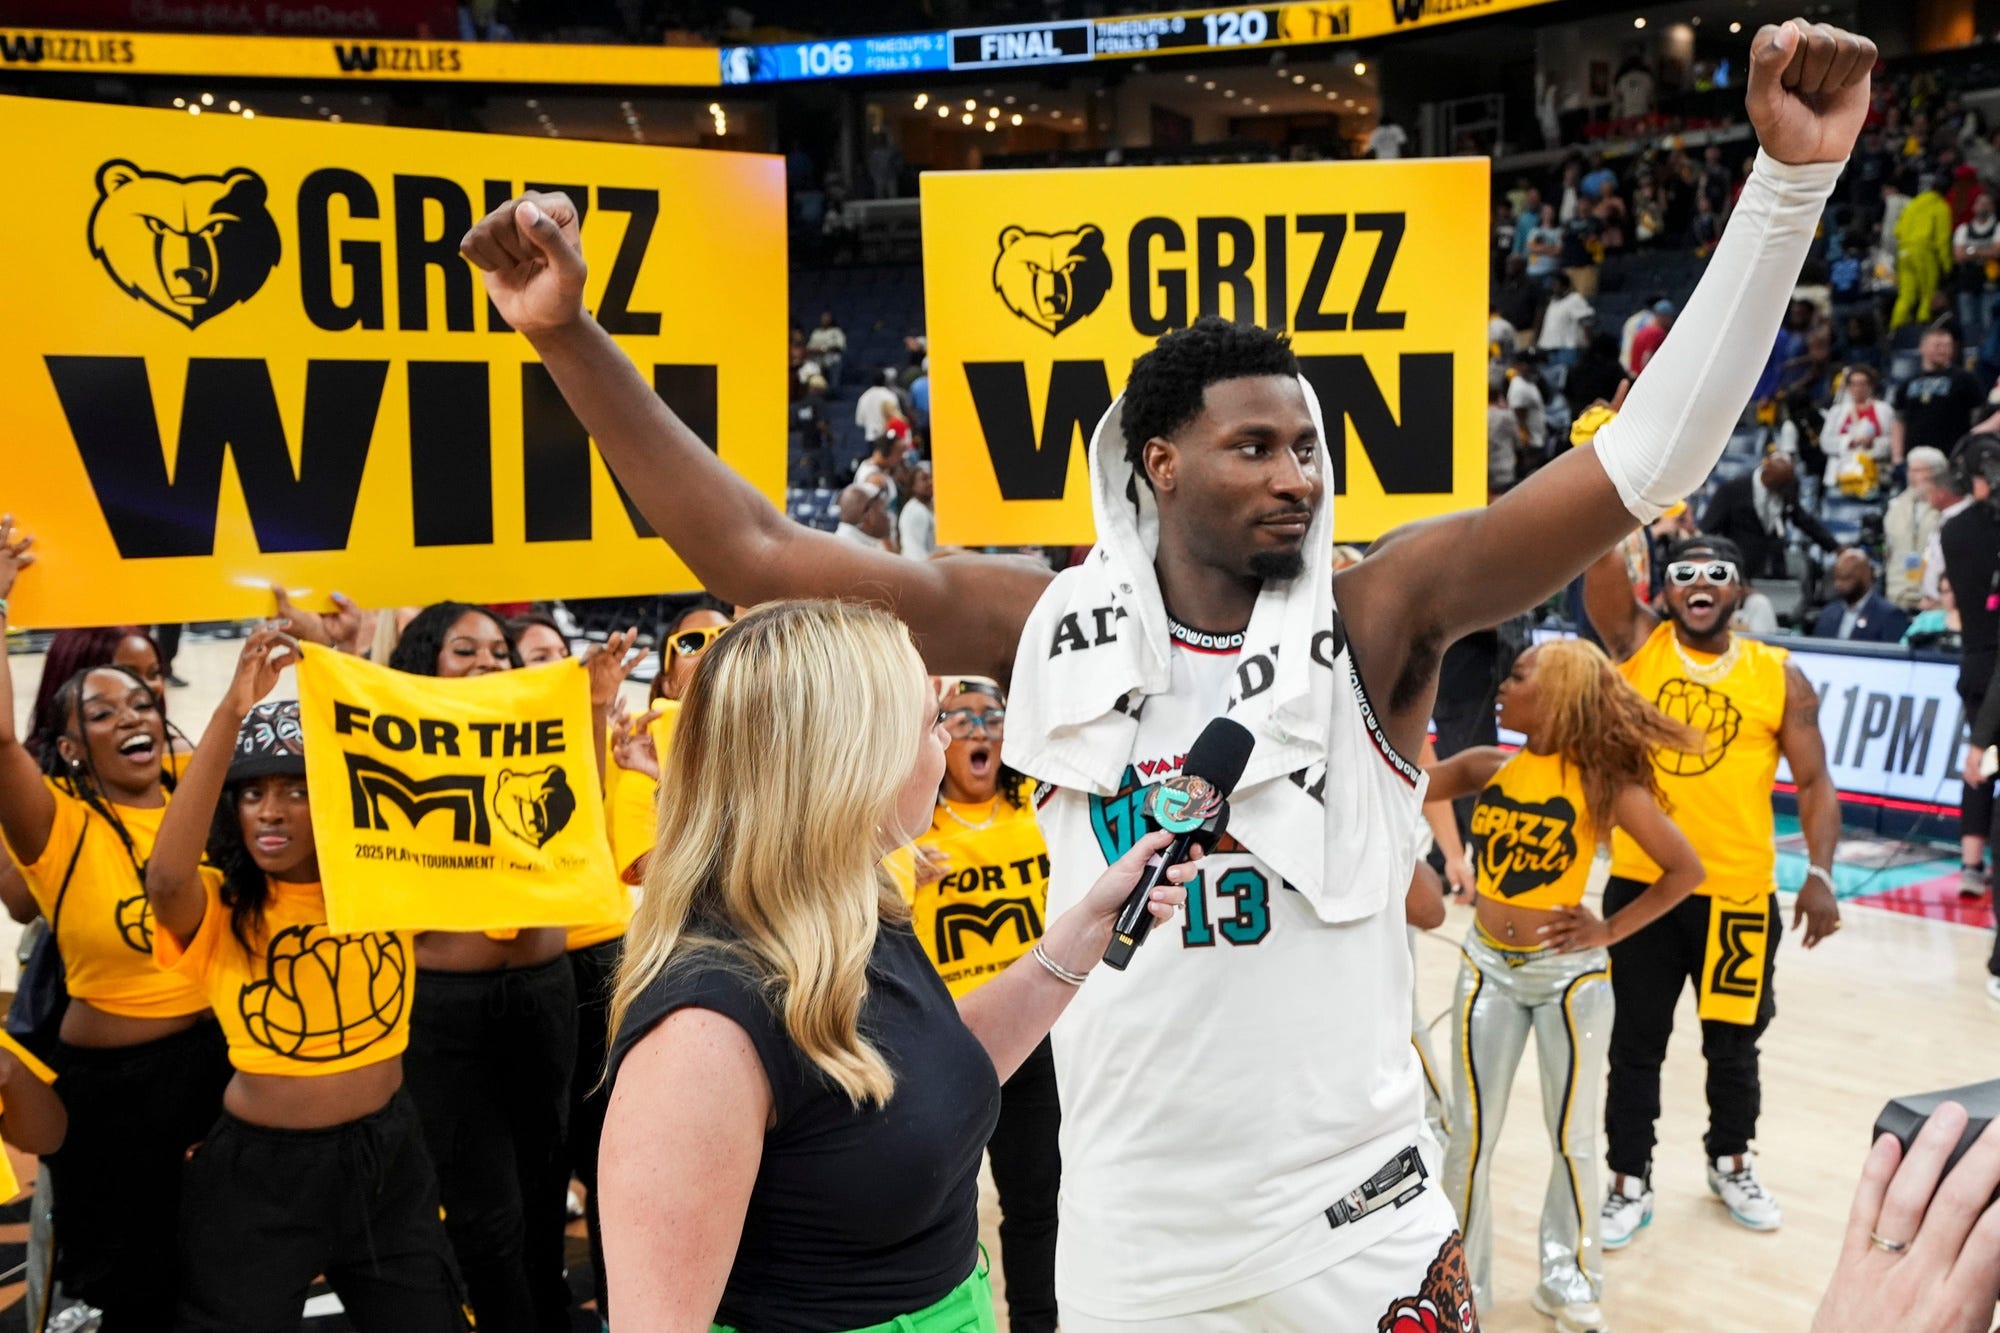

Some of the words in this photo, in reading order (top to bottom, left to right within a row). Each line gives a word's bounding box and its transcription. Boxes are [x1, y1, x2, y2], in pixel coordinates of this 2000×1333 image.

[980, 31, 1062, 61] FINAL
[1203, 10, 1268, 46] 120
[797, 42, 853, 76] 106
[296, 167, 662, 336] GRZ
[1128, 212, 1406, 336] GRIZZ
[963, 352, 1454, 501] WN
[43, 354, 718, 559] WIN
[333, 700, 460, 756] FOR
[468, 719, 566, 758] THE
[1832, 685, 1940, 776] 1PM
[1471, 804, 1567, 850] GRIZZ
[355, 844, 384, 860] 2025
[421, 854, 495, 870] TOURNAMENT
[938, 865, 1006, 896] FOR
[1181, 866, 1271, 948] 13
